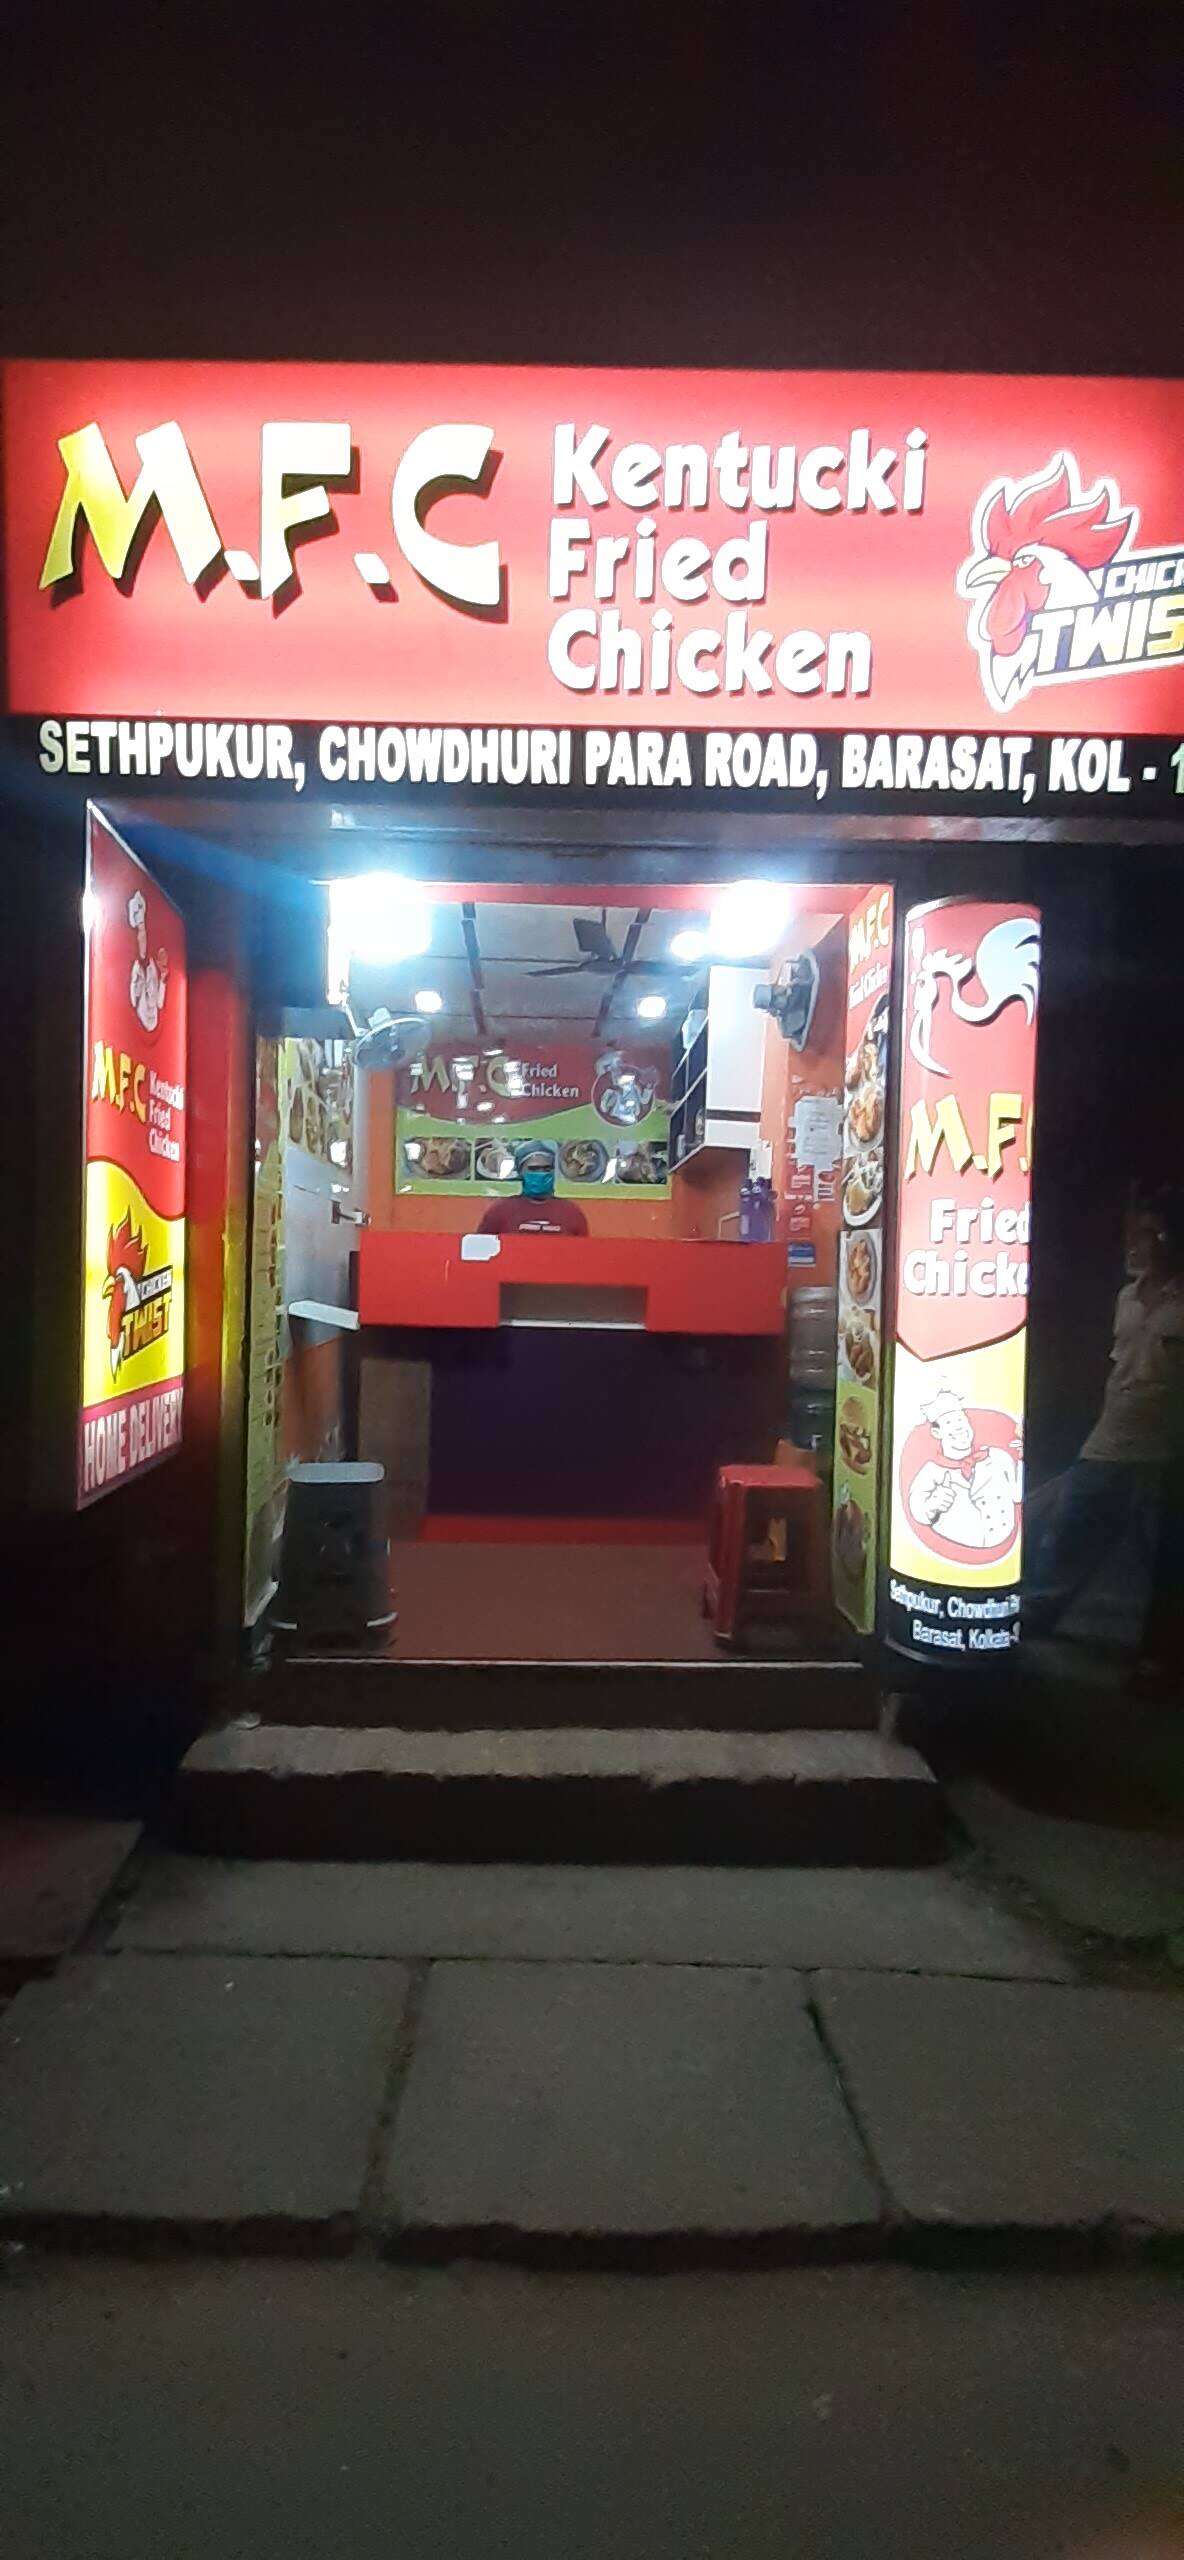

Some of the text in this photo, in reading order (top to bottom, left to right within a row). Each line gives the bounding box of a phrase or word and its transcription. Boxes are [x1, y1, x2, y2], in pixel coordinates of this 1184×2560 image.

[551, 422, 929, 513] Kentucki
[39, 420, 504, 612] M.F.C
[548, 516, 768, 603] Fried
[547, 608, 872, 695] Chicken
[39, 719, 306, 792] SETHPUKUR,
[319, 725, 572, 786] CHOWDHURI
[584, 731, 692, 788] PARA
[705, 733, 829, 800] ROAD,
[841, 735, 1035, 803] BARASAT,
[1048, 738, 1131, 793] KOL
[91, 1039, 147, 1124] M.F.C
[521, 1062, 557, 1080] Fried
[521, 1081, 579, 1098] Chicken
[904, 1092, 1034, 1183] M.F.
[930, 1197, 1032, 1243] Fried
[121, 1292, 172, 1357] TWIST
[84, 1387, 184, 1492] HOME DELIVERY
[913, 1619, 966, 1652] Barasat,
